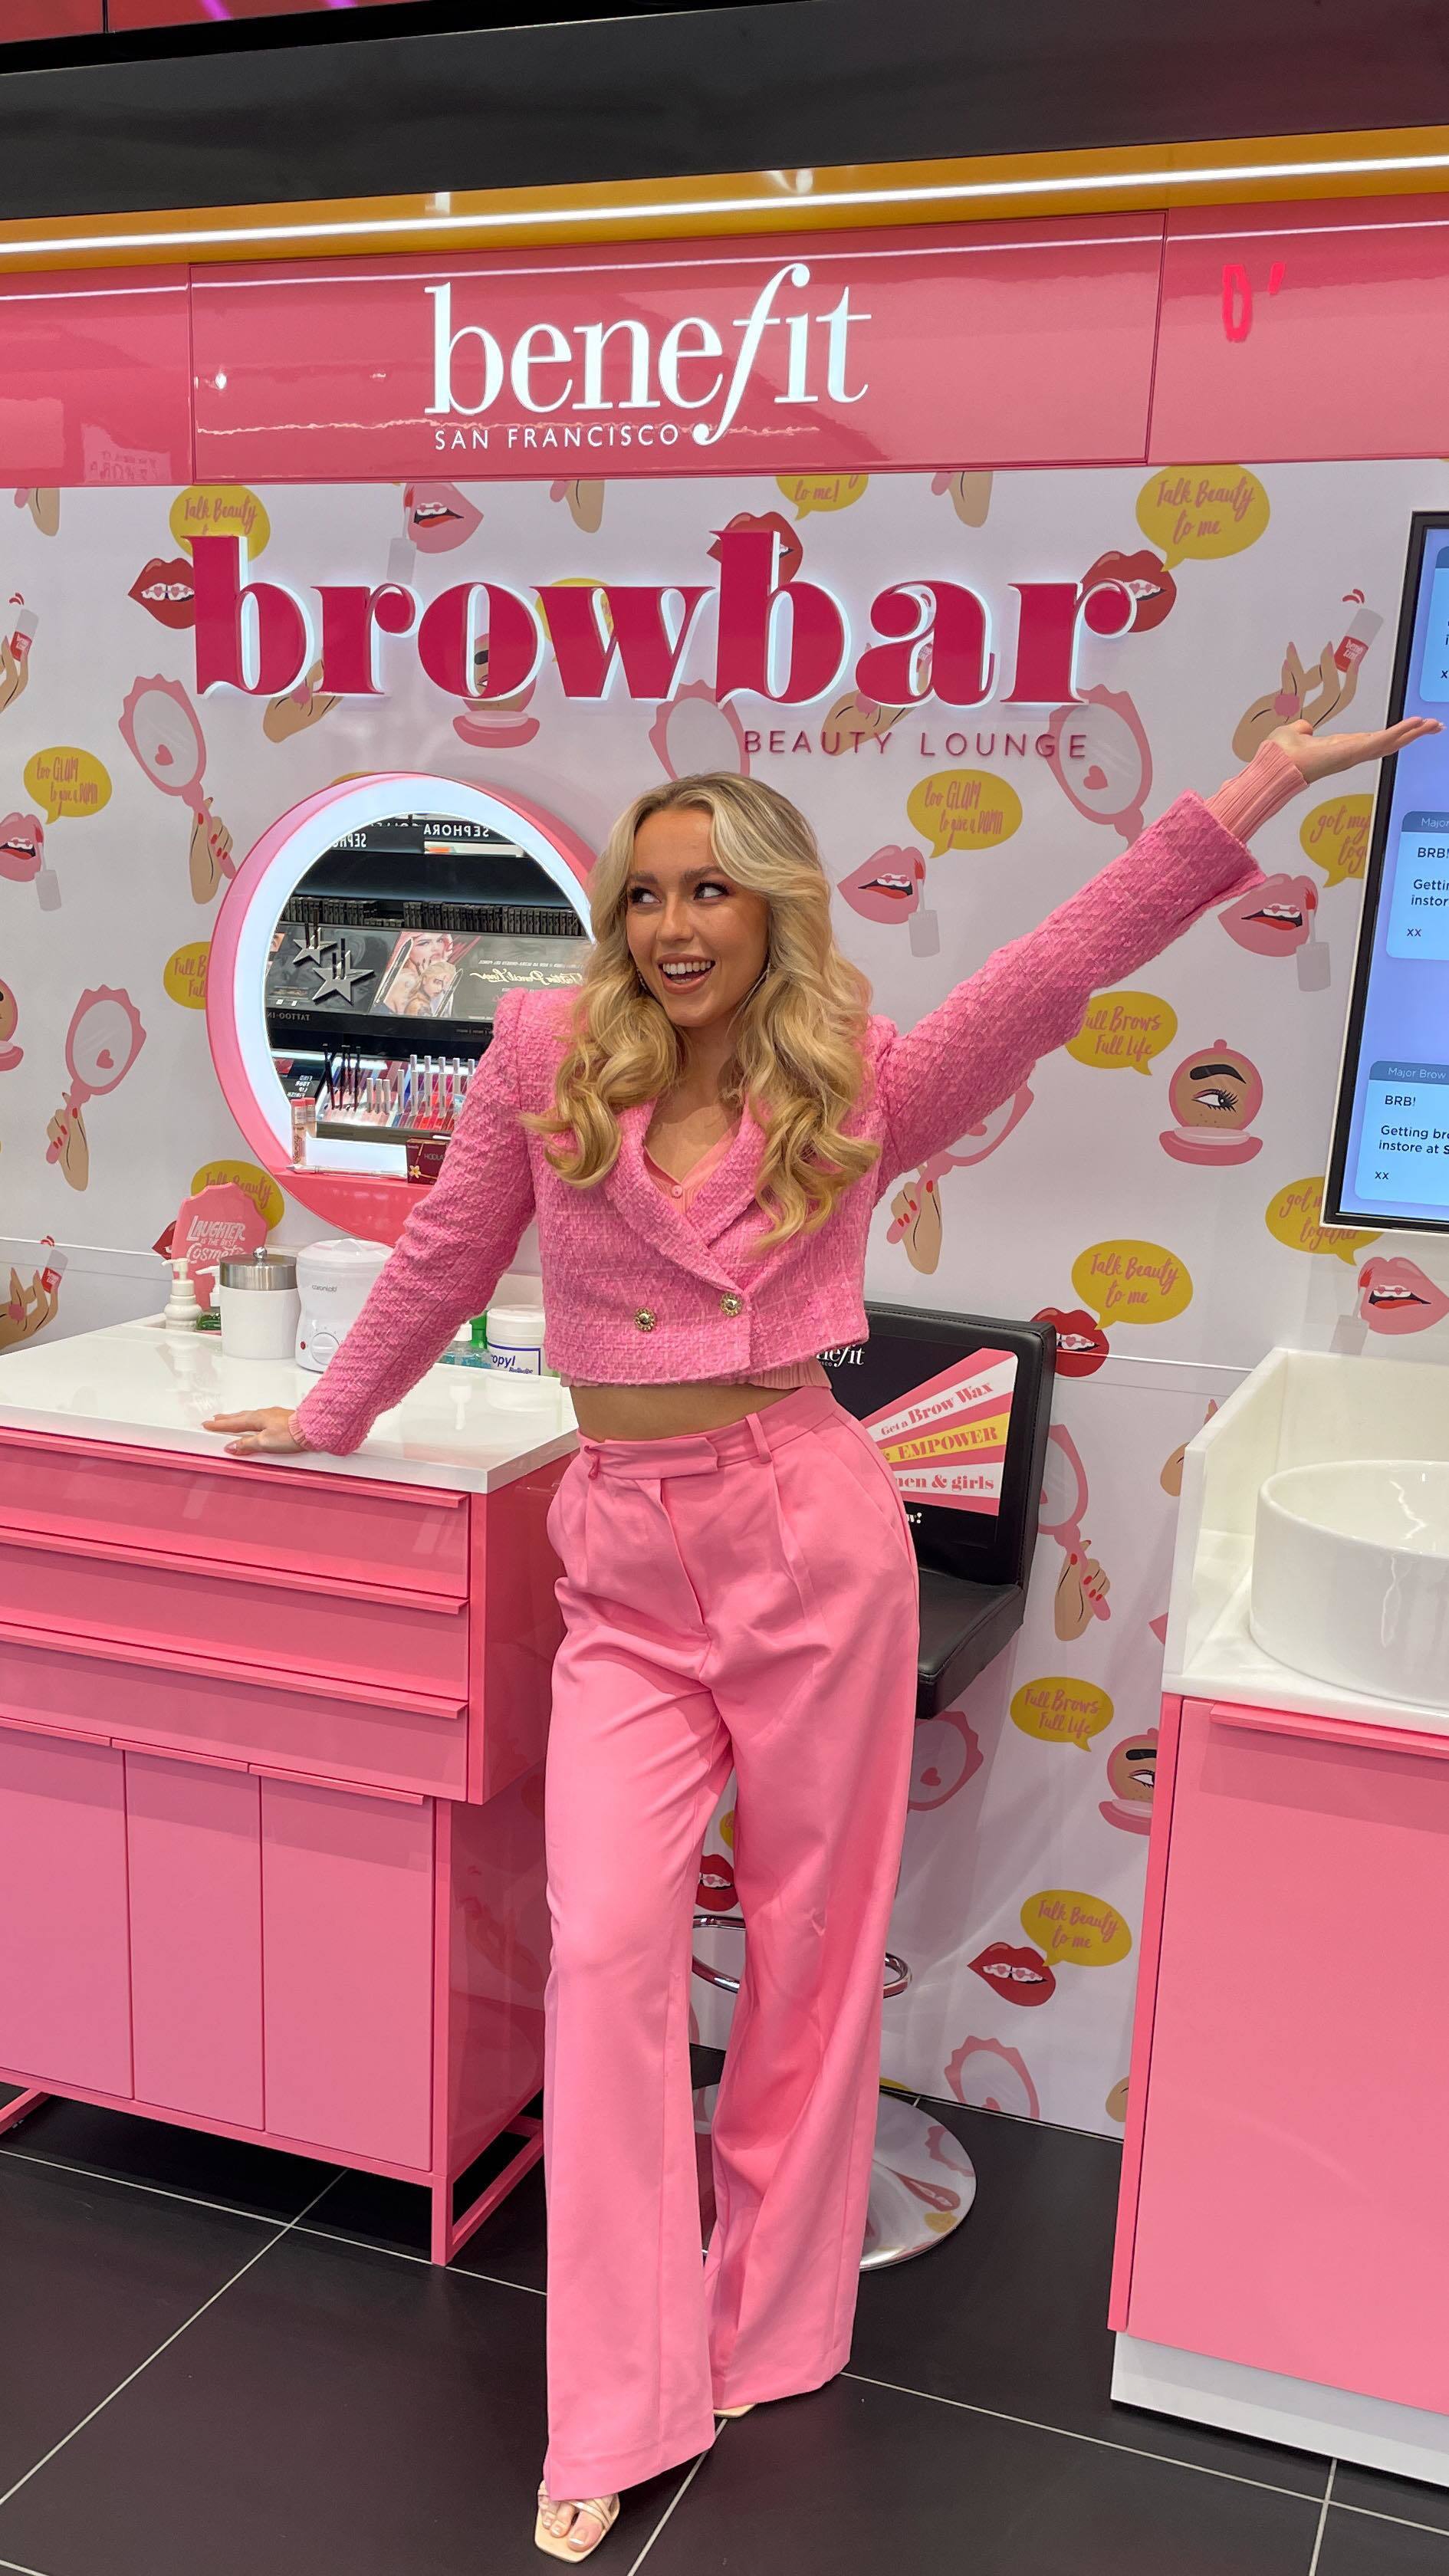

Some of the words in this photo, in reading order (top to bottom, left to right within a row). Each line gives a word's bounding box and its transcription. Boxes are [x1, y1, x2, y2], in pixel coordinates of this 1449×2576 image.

[424, 262, 872, 446] benefit
[435, 429, 488, 450] SAN
[508, 423, 679, 449] FRANCISCO
[795, 479, 811, 501] to
[1156, 478, 1192, 508] Talk
[1194, 476, 1256, 522] Beauty
[184, 495, 210, 521] Talk
[213, 495, 258, 534] Beauty
[1173, 509, 1194, 544] to
[1197, 521, 1221, 537] me
[182, 527, 1135, 709] browbar
[744, 730, 892, 754] BEAUTY
[921, 731, 1088, 759] LOUNGE
[925, 780, 944, 807] too
[946, 780, 981, 810] GLAM
[1309, 805, 1346, 843] got
[1407, 928, 1421, 937] xx
[174, 956, 196, 976] Full
[1084, 1010, 1108, 1030] ull
[1109, 1006, 1163, 1033] Brows
[1095, 1034, 1123, 1055] Full
[1125, 1036, 1153, 1062] Life
[1388, 1066, 1417, 1079] Major
[1419, 1069, 1447, 1079] Brow
[1385, 1095, 1416, 1106] BRB!
[1378, 1139, 1423, 1152] instore
[1426, 1144, 1439, 1154] at
[1381, 1125, 1428, 1140] Getting
[1375, 1171, 1389, 1180] xx
[1279, 1186, 1313, 1218] got
[186, 1215, 245, 1241] LAUGHTER
[1090, 1253, 1123, 1276] Talk
[1125, 1256, 1179, 1295] Beauty
[1106, 1280, 1125, 1309] to
[1127, 1291, 1149, 1304] me
[491, 1355, 516, 1368] opyl
[881, 1422, 899, 1436] Get
[901, 1419, 909, 1428] a
[908, 1397, 955, 1424] Brow
[955, 1382, 994, 1404] Wax
[898, 1426, 998, 1460] EMPOWER
[932, 1474, 948, 1488] &
[951, 1476, 994, 1492] girls
[1024, 1688, 1050, 1708] Full
[1051, 1688, 1099, 1714] Brows
[1038, 1711, 1066, 1731] Full
[1067, 1717, 1092, 1740] Life
[1038, 1899, 1067, 1921] Talk
[1069, 1907, 1118, 1943] Beauty
[1053, 1924, 1071, 1948] to
[1072, 1937, 1092, 1949] me
